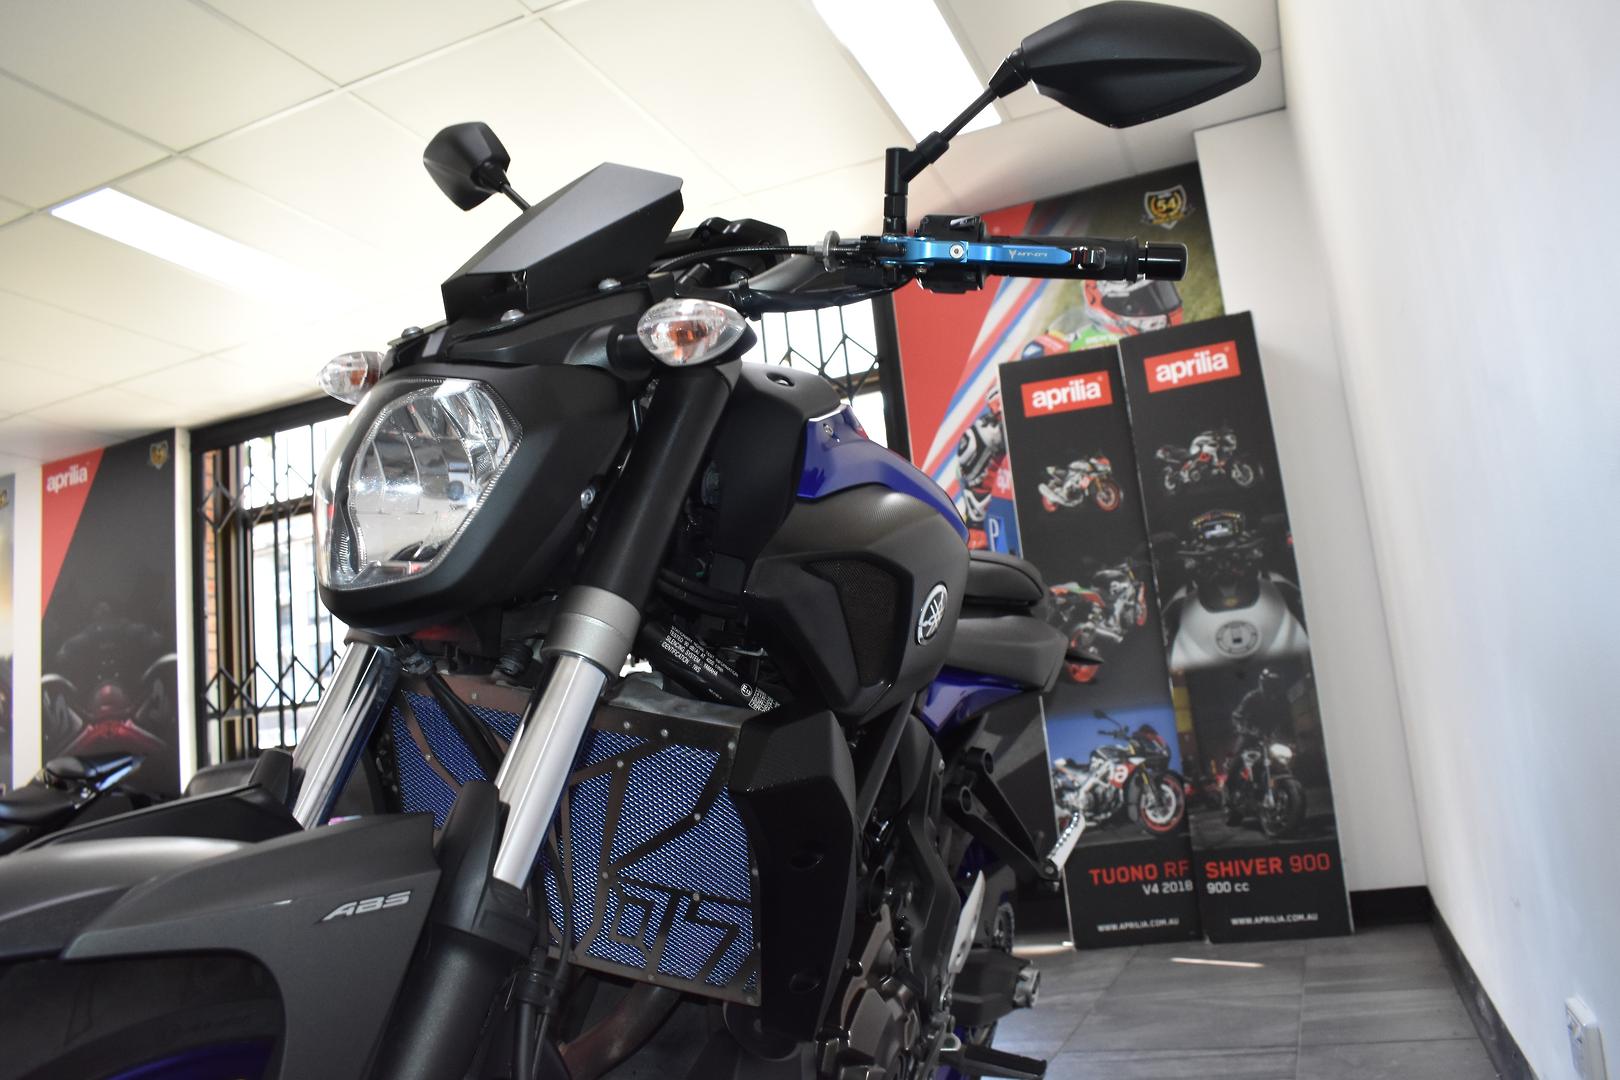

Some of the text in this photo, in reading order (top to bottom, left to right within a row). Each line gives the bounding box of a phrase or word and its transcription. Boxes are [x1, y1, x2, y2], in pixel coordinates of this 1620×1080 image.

[1155, 350, 1228, 384] aprilia
[1032, 380, 1102, 410] aprilia
[47, 464, 88, 493] aprilia
[1088, 863, 1158, 885] TUONO
[1205, 853, 1330, 879] SHIVER 900
[1142, 882, 1159, 895] V4
[1206, 881, 1249, 894] 900 cc
[322, 890, 411, 921] ABS
